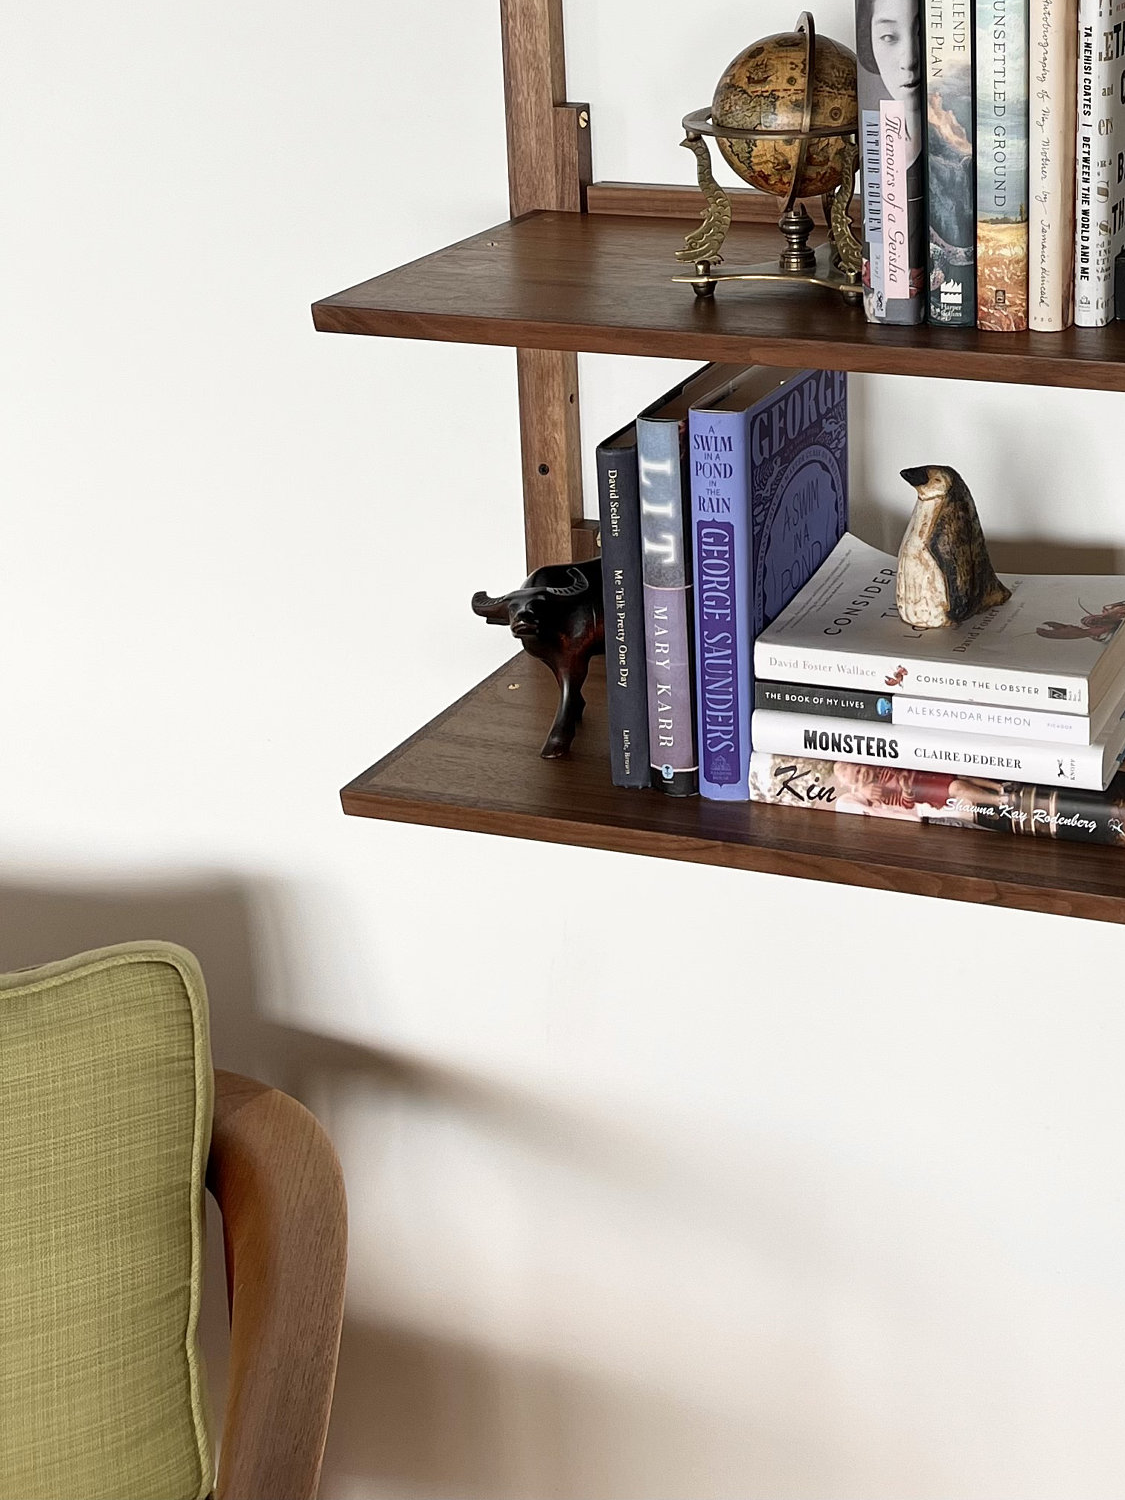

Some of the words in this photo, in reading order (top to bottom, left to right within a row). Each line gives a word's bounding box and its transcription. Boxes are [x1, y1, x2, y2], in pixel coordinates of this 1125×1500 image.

[931, 36, 945, 78] PLAN
[993, 0, 1006, 118] UNSETTLED
[1083, 26, 1093, 75] TA-NEHISI
[1036, 88, 1051, 102] of
[1082, 77, 1092, 117] COATES
[1036, 107, 1051, 134] My
[866, 121, 880, 174] ARTHUR
[884, 112, 902, 187] Memoirs
[1041, 137, 1051, 181] Mother
[1081, 136, 1091, 184] BETWEEN
[993, 125, 1006, 207] GROUND
[867, 182, 882, 232] GOLDEN
[882, 192, 904, 215] of
[1081, 186, 1091, 206] THE
[887, 216, 896, 224] a
[1080, 208, 1090, 242] WORLD
[888, 231, 905, 283] Geisha
[1040, 219, 1051, 266] Jamaica
[1080, 244, 1090, 264] AND
[1079, 266, 1089, 281] ME
[708, 425, 715, 434] A
[752, 369, 847, 468] GEORGE
[693, 433, 733, 452] SWIM
[704, 452, 713, 460] IN
[608, 469, 619, 499] David
[695, 461, 733, 479] POND
[698, 495, 731, 513] RAIN
[706, 488, 721, 496] THE
[792, 476, 820, 528] SWIM
[610, 501, 621, 538] Sedaris
[641, 456, 675, 564] LIT
[614, 570, 623, 586] Me
[701, 528, 731, 622] GEORGE
[615, 587, 626, 610] Talk
[824, 567, 898, 636] CONSIDER
[615, 614, 628, 643] Pretty
[653, 605, 671, 670] MARY
[952, 632, 980, 653] David
[618, 645, 628, 667] One
[769, 656, 799, 669] David
[802, 660, 833, 673] Foster
[837, 663, 877, 677] Wallace
[618, 668, 629, 689] Day
[703, 631, 735, 754] SAUNDERS
[916, 674, 968, 687] CONSIDER
[972, 680, 991, 690] THE
[995, 683, 1040, 695] LOBSTER
[765, 691, 781, 700] THE
[785, 694, 810, 703] BOOK
[813, 697, 824, 705] OF
[827, 698, 839, 706] MY
[841, 700, 865, 709] LIVES
[656, 683, 674, 748] KARR
[907, 706, 983, 722] ALEKSANDAR
[988, 715, 1032, 727] HEMON
[804, 729, 899, 759] MONSTERS
[914, 747, 961, 762] CLAIRE
[963, 753, 1022, 769] DEDERER
[774, 765, 837, 803] Kin
[945, 798, 996, 816] Shawna
[999, 804, 1028, 822] Kay
[1032, 808, 1097, 833] Rodenberg
